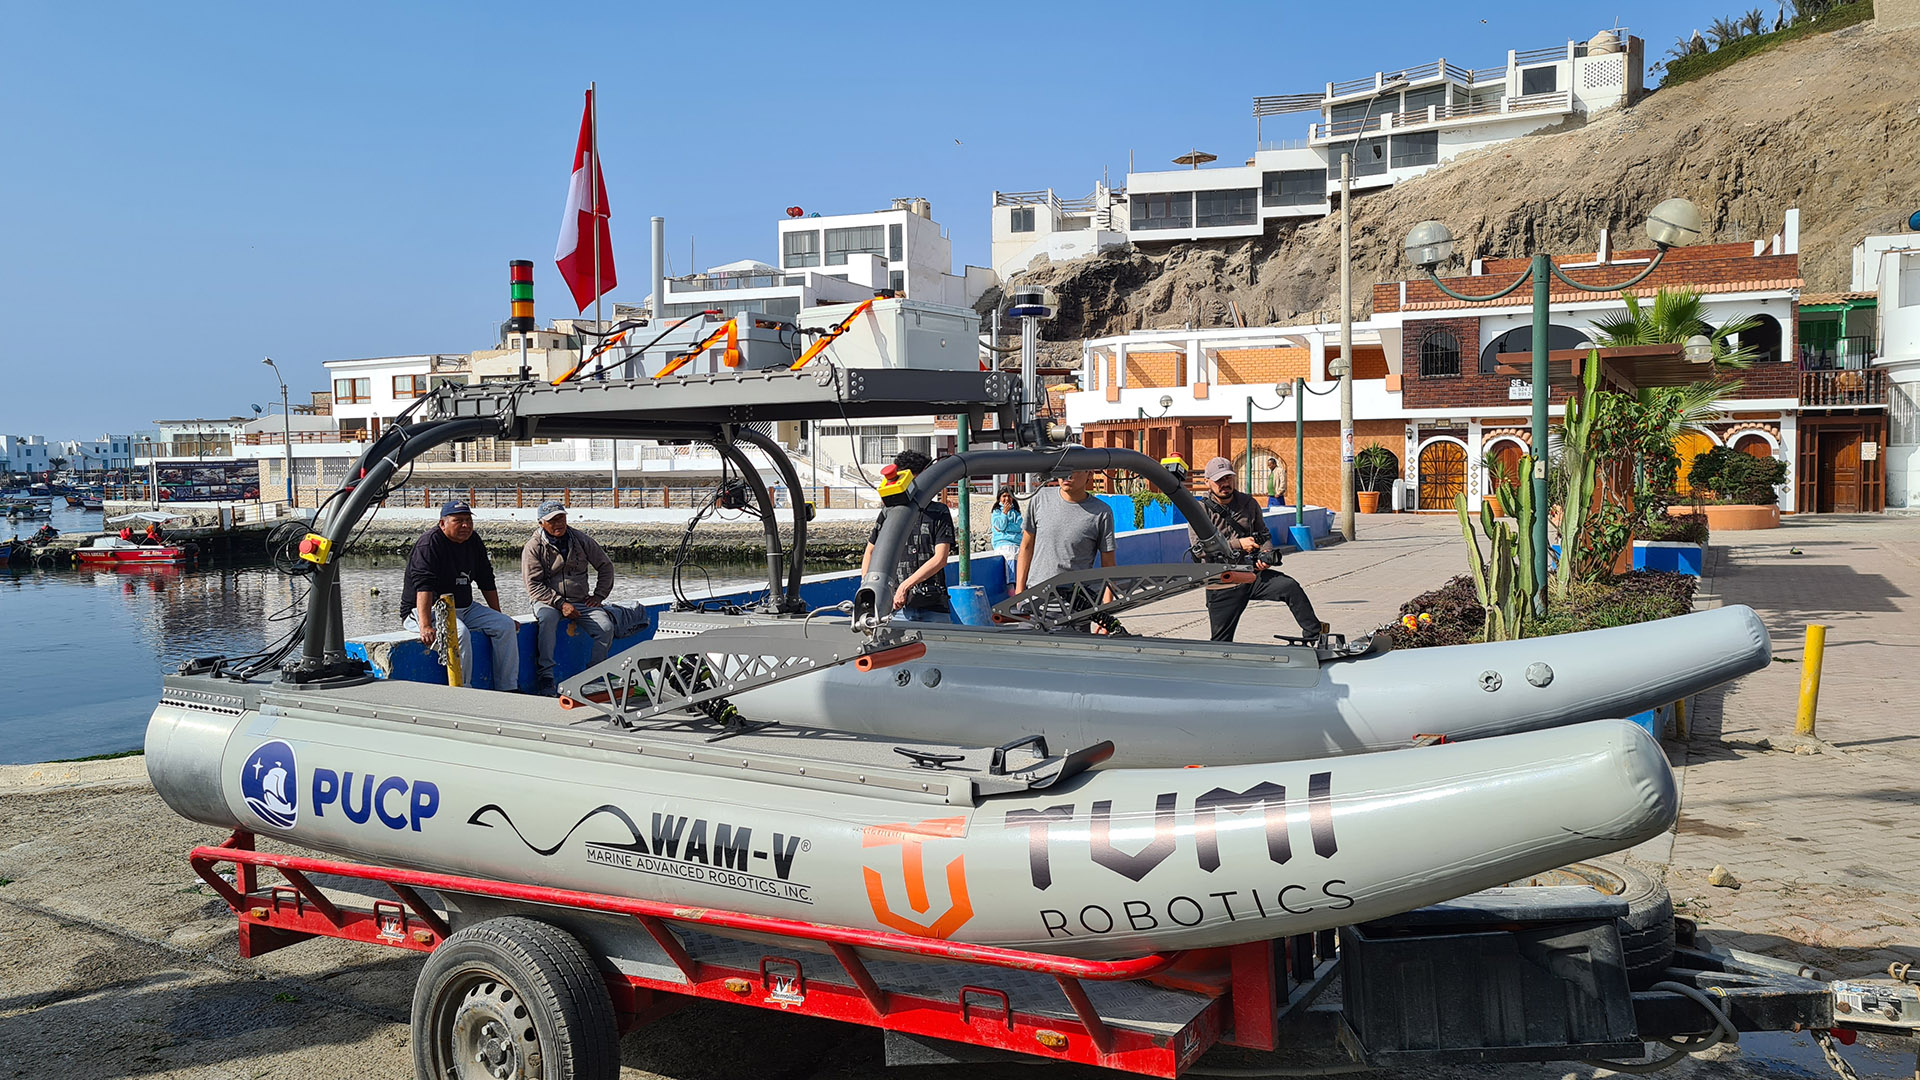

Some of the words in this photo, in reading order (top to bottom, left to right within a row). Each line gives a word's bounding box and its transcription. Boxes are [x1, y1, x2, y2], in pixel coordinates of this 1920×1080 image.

[312, 768, 440, 832] PUCP
[1004, 771, 1338, 891] TUMI
[587, 848, 632, 867] MARINE
[636, 858, 705, 880] ADVANCED
[709, 870, 781, 896] ROBOTICS,
[785, 885, 812, 901] INC.
[1040, 879, 1355, 938] ROBOTICS
